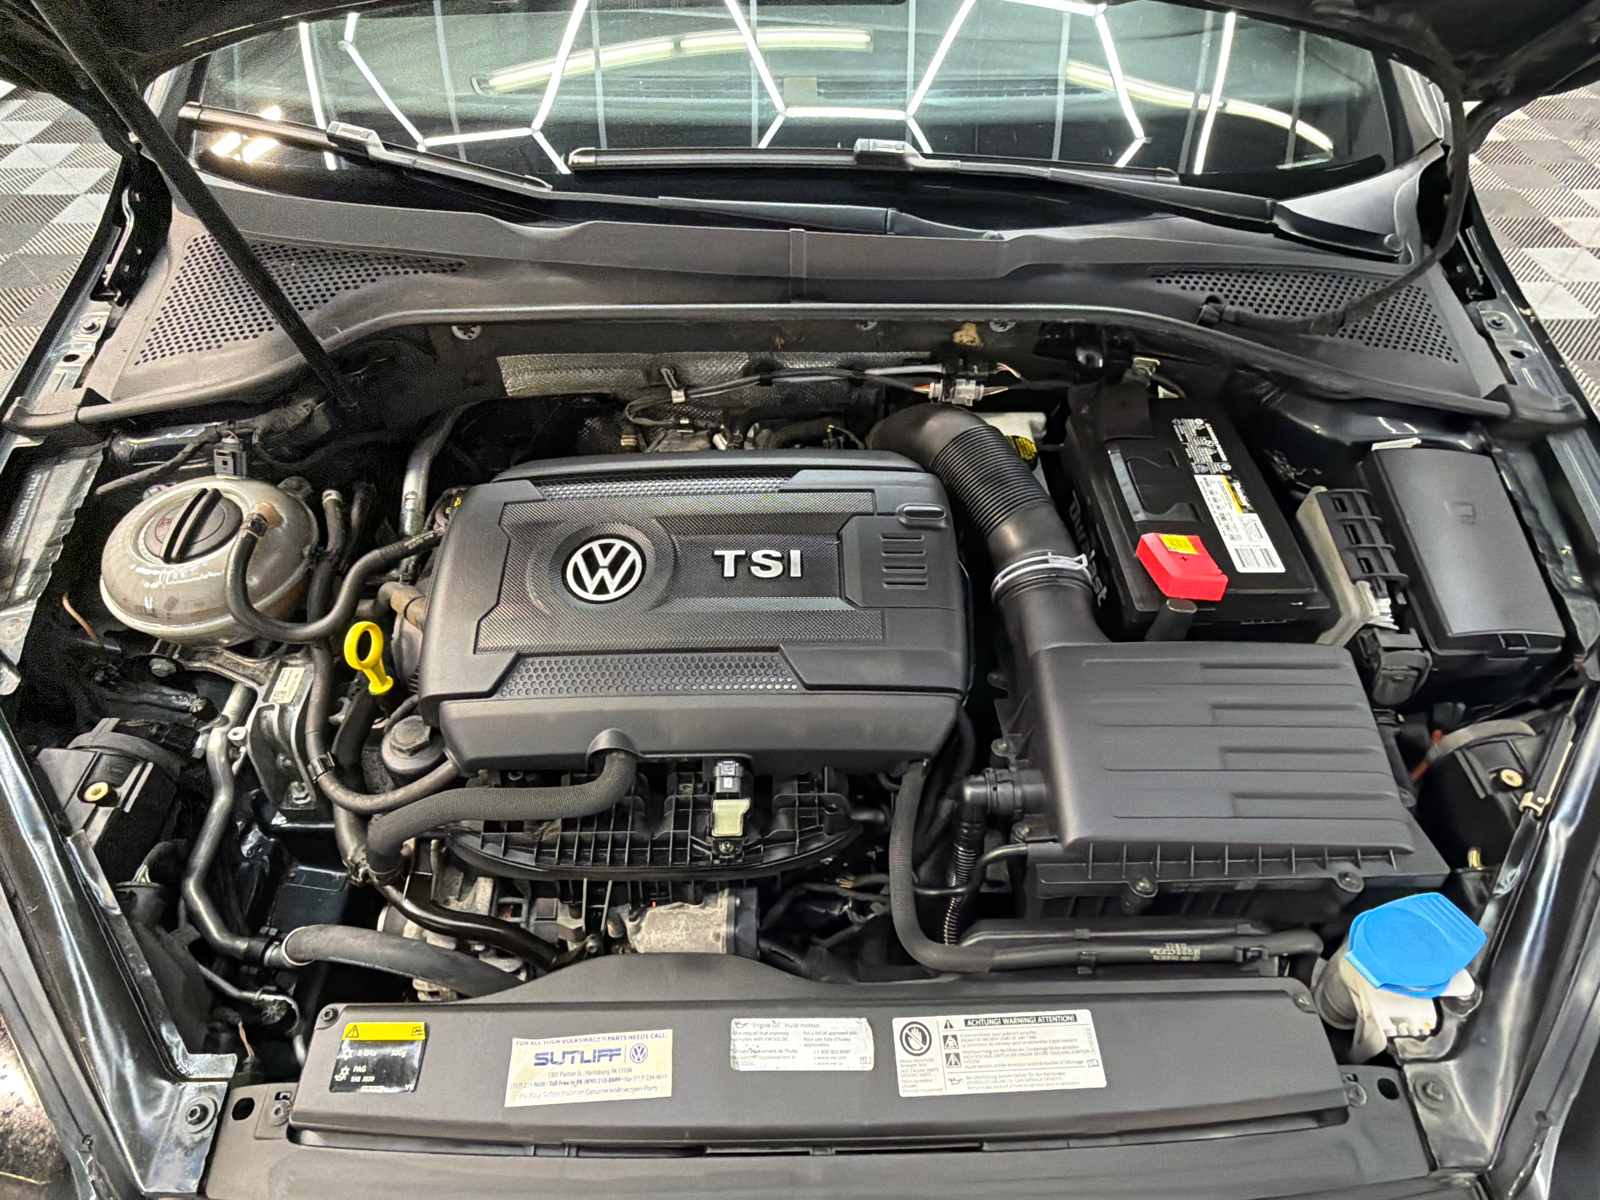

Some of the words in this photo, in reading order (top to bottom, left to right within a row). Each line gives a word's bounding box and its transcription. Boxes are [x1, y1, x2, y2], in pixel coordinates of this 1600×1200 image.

[713, 549, 802, 578] TSI
[967, 1018, 1001, 1026] ACHTUNG!
[1002, 1015, 1037, 1025] WARNING!
[1038, 1014, 1076, 1023] ATTENTION!
[562, 1036, 606, 1044] VOLKSWAGEN
[533, 1047, 622, 1067] SUTLIFF
